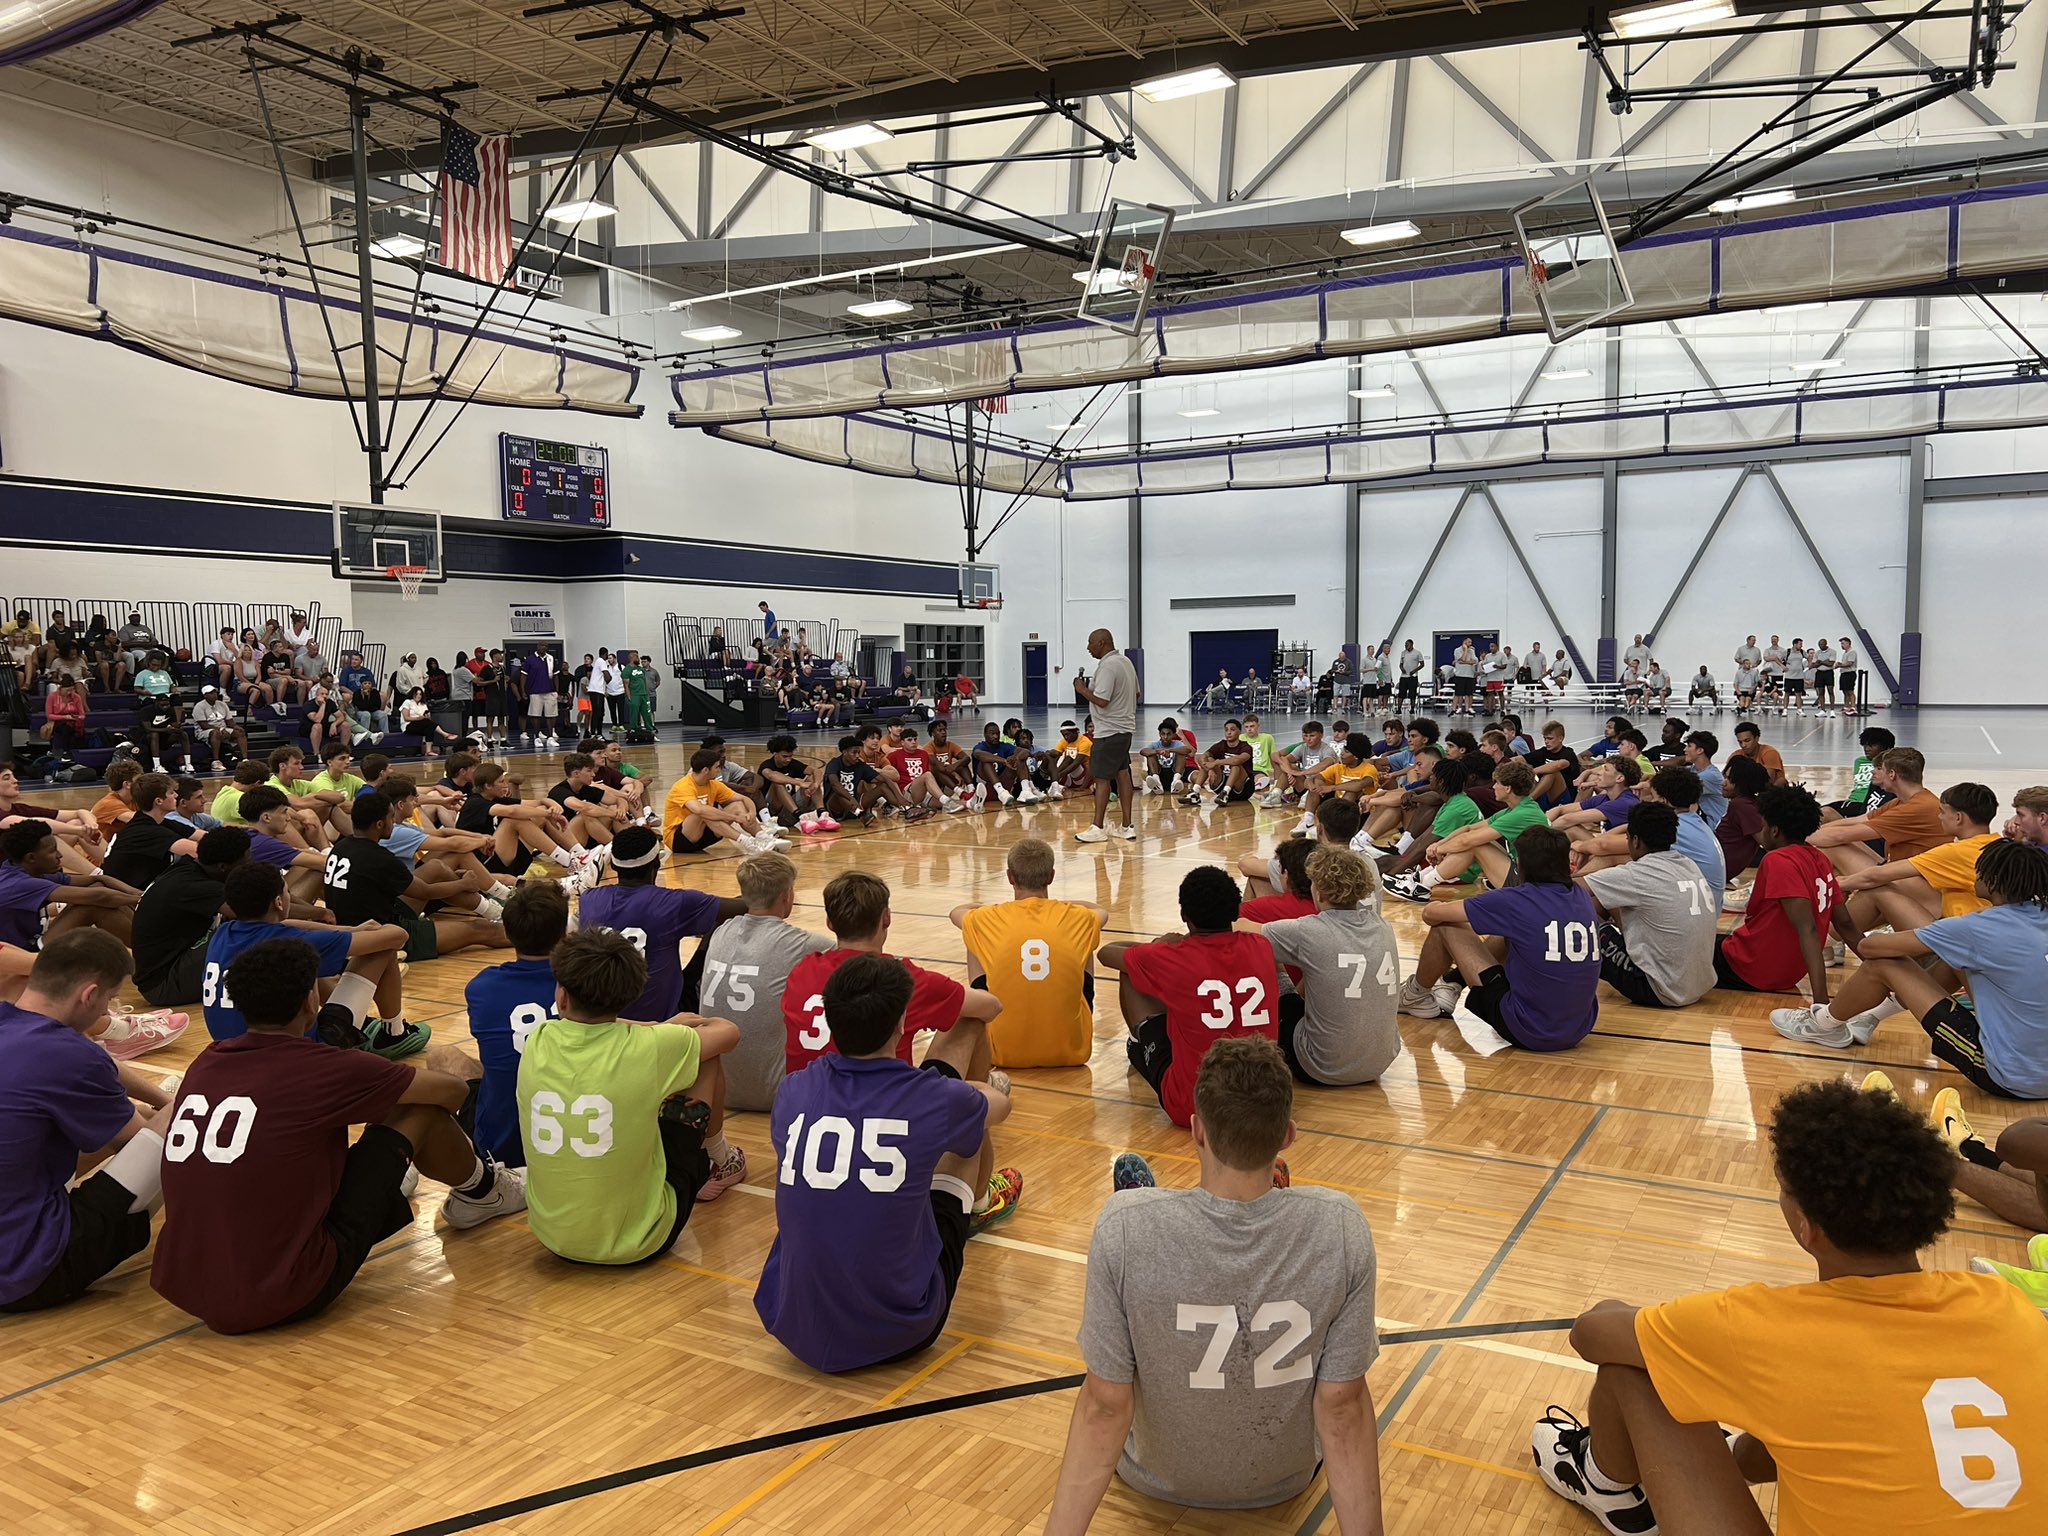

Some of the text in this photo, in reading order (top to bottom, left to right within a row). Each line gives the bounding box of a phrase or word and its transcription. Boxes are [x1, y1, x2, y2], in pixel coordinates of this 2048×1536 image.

[509, 457, 531, 467] HOME
[523, 468, 531, 485] 0
[515, 492, 523, 509] 0
[594, 477, 602, 494] 0
[595, 501, 603, 518] 0
[514, 610, 551, 618] GIANTS
[840, 774, 854, 783] TOP
[907, 766, 923, 777] 100
[324, 854, 350, 889] 92
[1021, 939, 1051, 981] 8
[1544, 920, 1600, 962] 101
[703, 960, 759, 1012] 75
[1338, 951, 1397, 998] 74
[1197, 976, 1270, 1029] 32
[165, 1094, 258, 1164] 60
[530, 1091, 614, 1157] 63
[780, 1113, 909, 1193] 105
[1176, 1299, 1314, 1390] 72
[1921, 1376, 2023, 1509] 6
